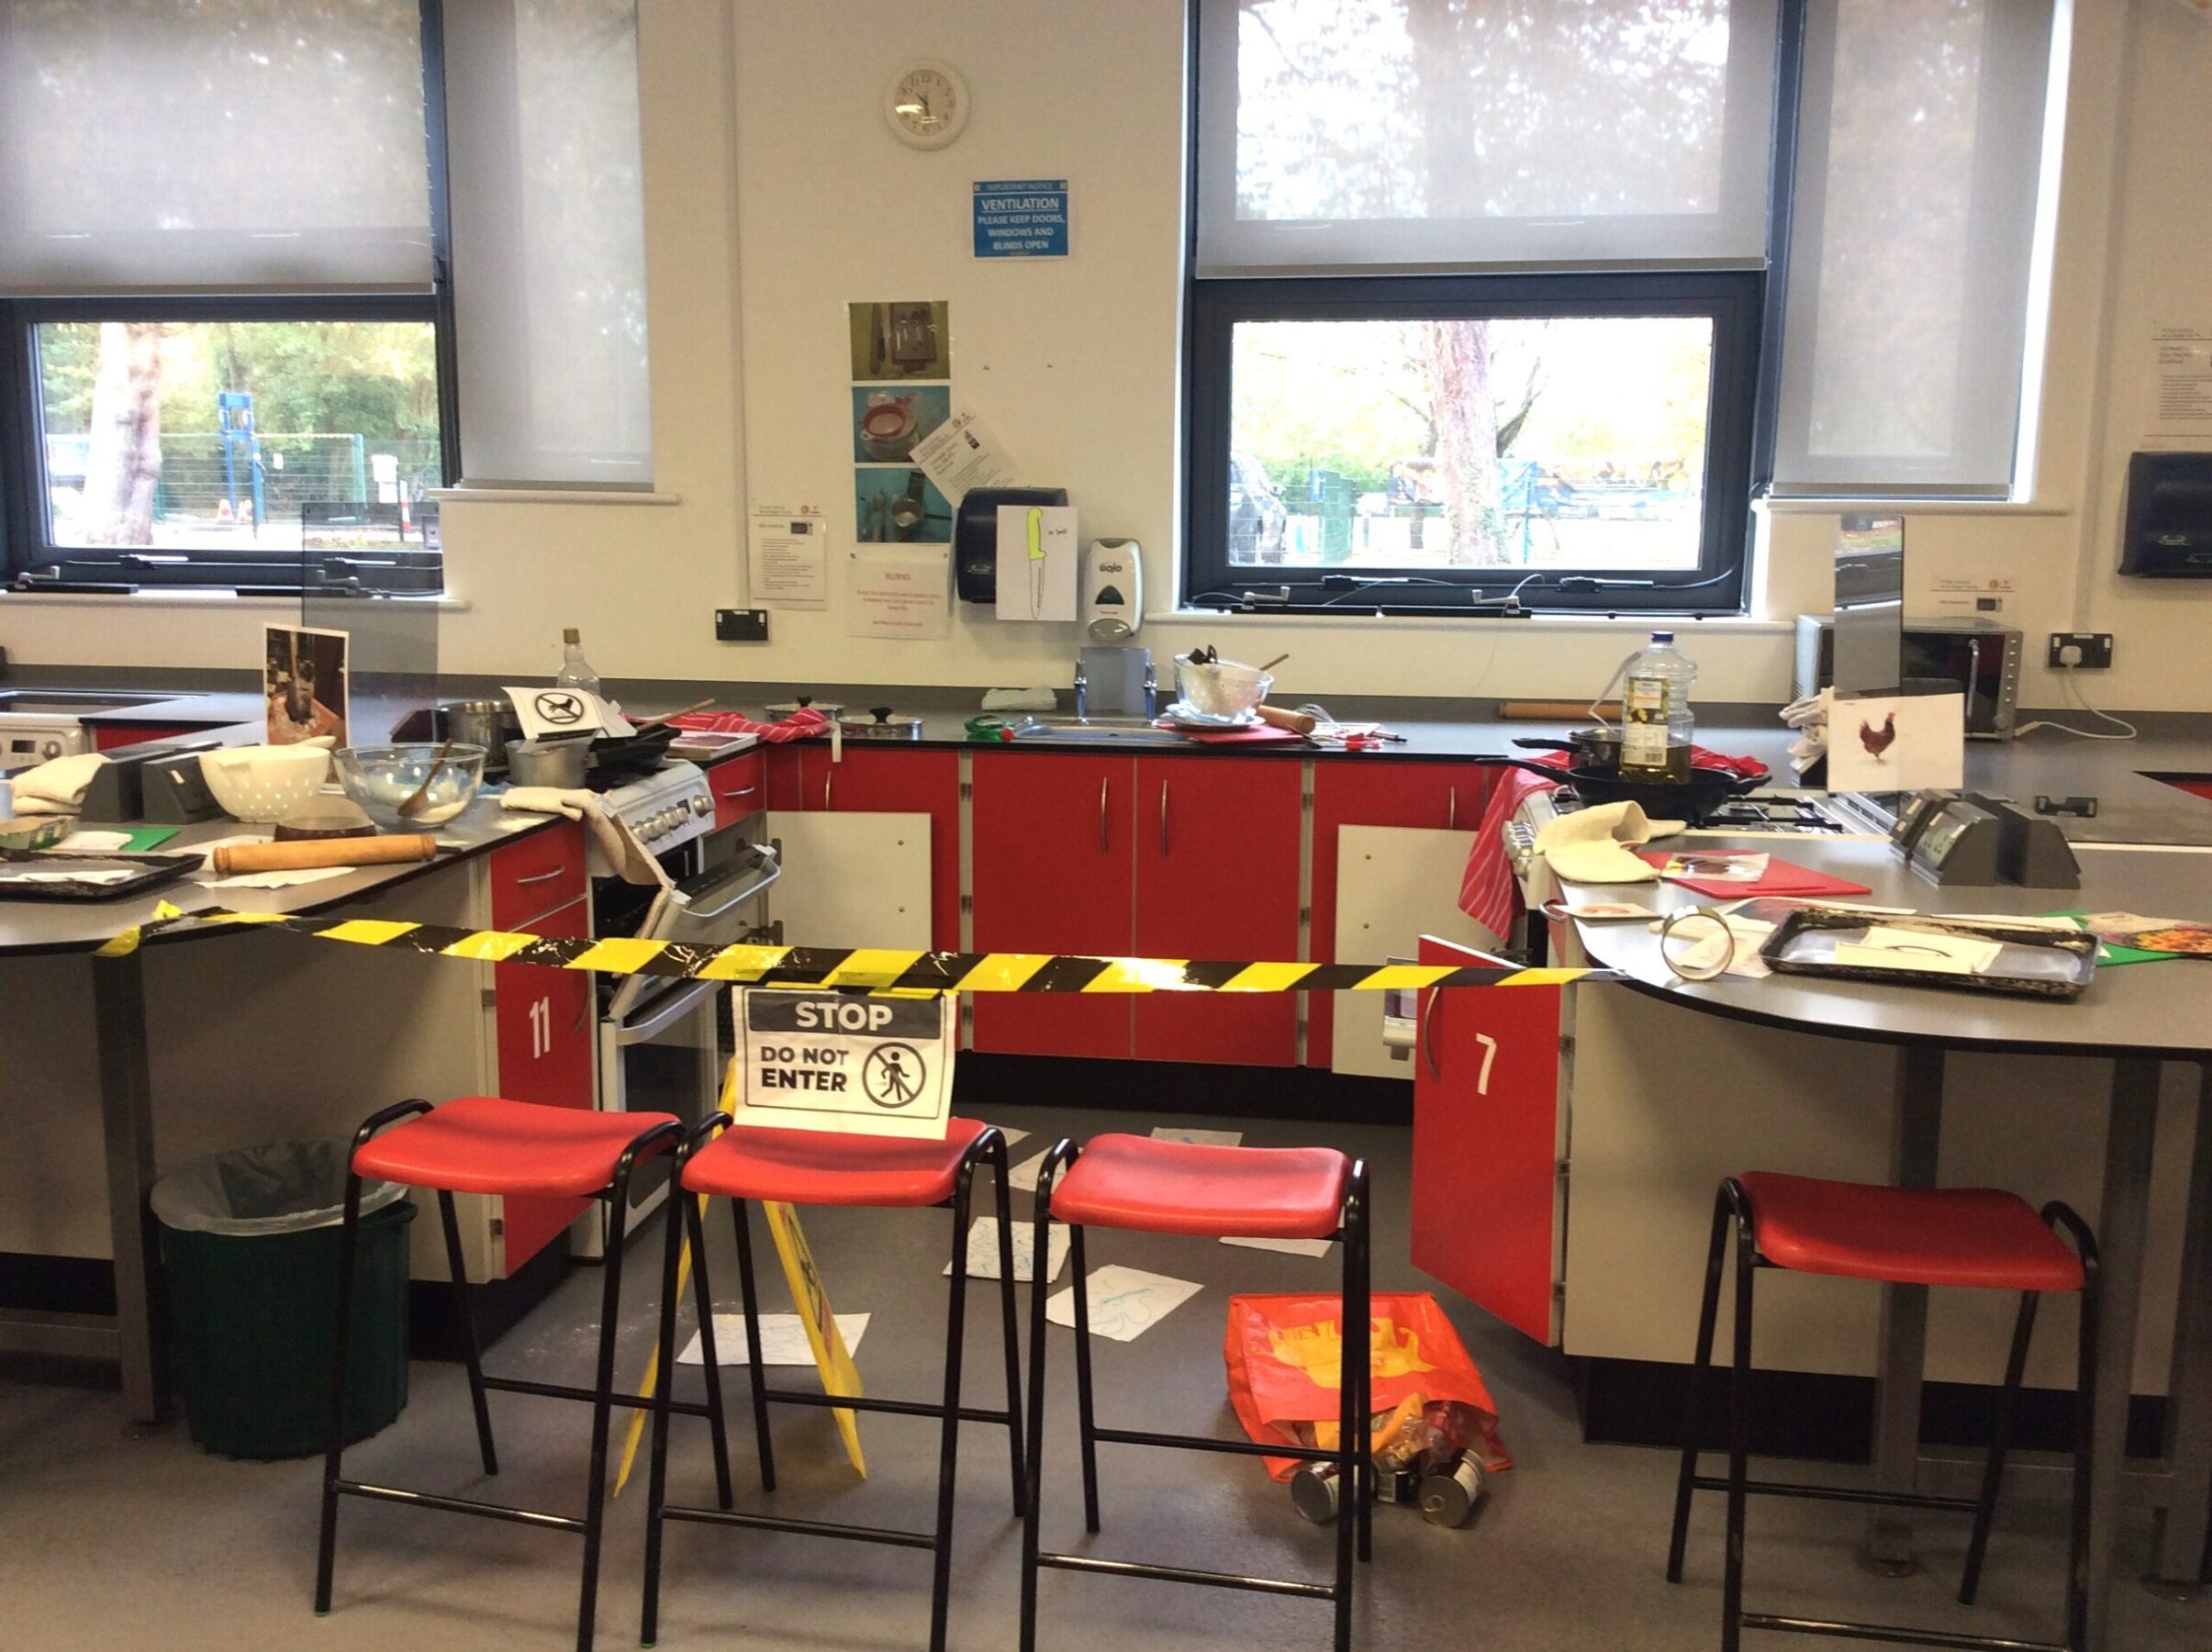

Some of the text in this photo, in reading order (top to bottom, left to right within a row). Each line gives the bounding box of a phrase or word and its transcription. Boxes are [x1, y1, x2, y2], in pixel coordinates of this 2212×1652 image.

[981, 197, 1059, 210] VENTILATION
[978, 215, 1008, 225] PLEASE
[1010, 215, 1030, 224] KEEP
[988, 227, 1054, 237] WINDOWS AND
[993, 240, 1049, 251] BLINDS OPEN
[795, 1001, 893, 1031] STOP
[529, 996, 551, 1059] 11
[761, 1046, 849, 1066] DO NOT
[1475, 1032, 1497, 1095] 7
[761, 1068, 847, 1092] ENTER
